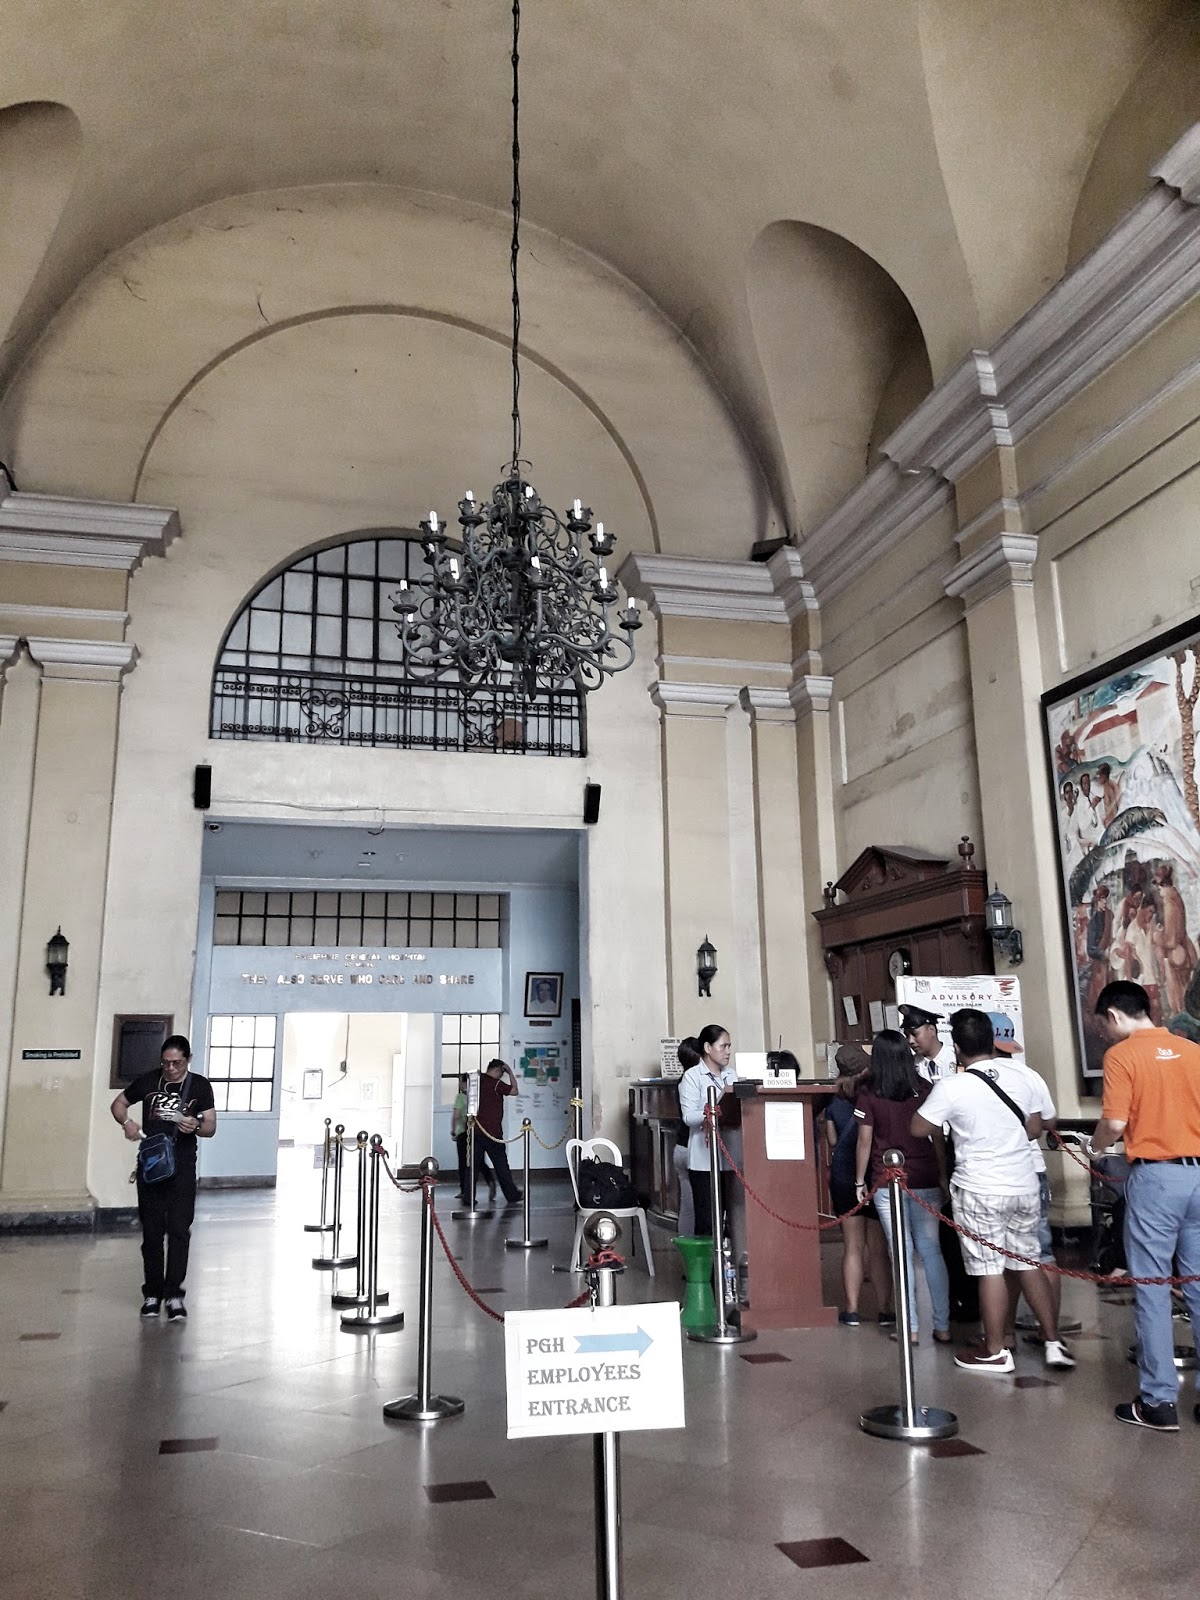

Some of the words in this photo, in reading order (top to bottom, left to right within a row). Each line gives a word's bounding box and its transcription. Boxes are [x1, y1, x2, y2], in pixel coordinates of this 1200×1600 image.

[277, 973, 305, 985] ALSO
[310, 973, 344, 985] SERVE
[350, 973, 373, 985] WHO
[379, 974, 405, 985] CARE
[412, 974, 433, 985] AND
[439, 974, 475, 985] SHARE
[931, 993, 992, 1001] ADVISORY
[526, 1337, 565, 1354] PGH
[527, 1363, 641, 1385] EMPLOYEES
[528, 1396, 632, 1417] ENTRANCE
